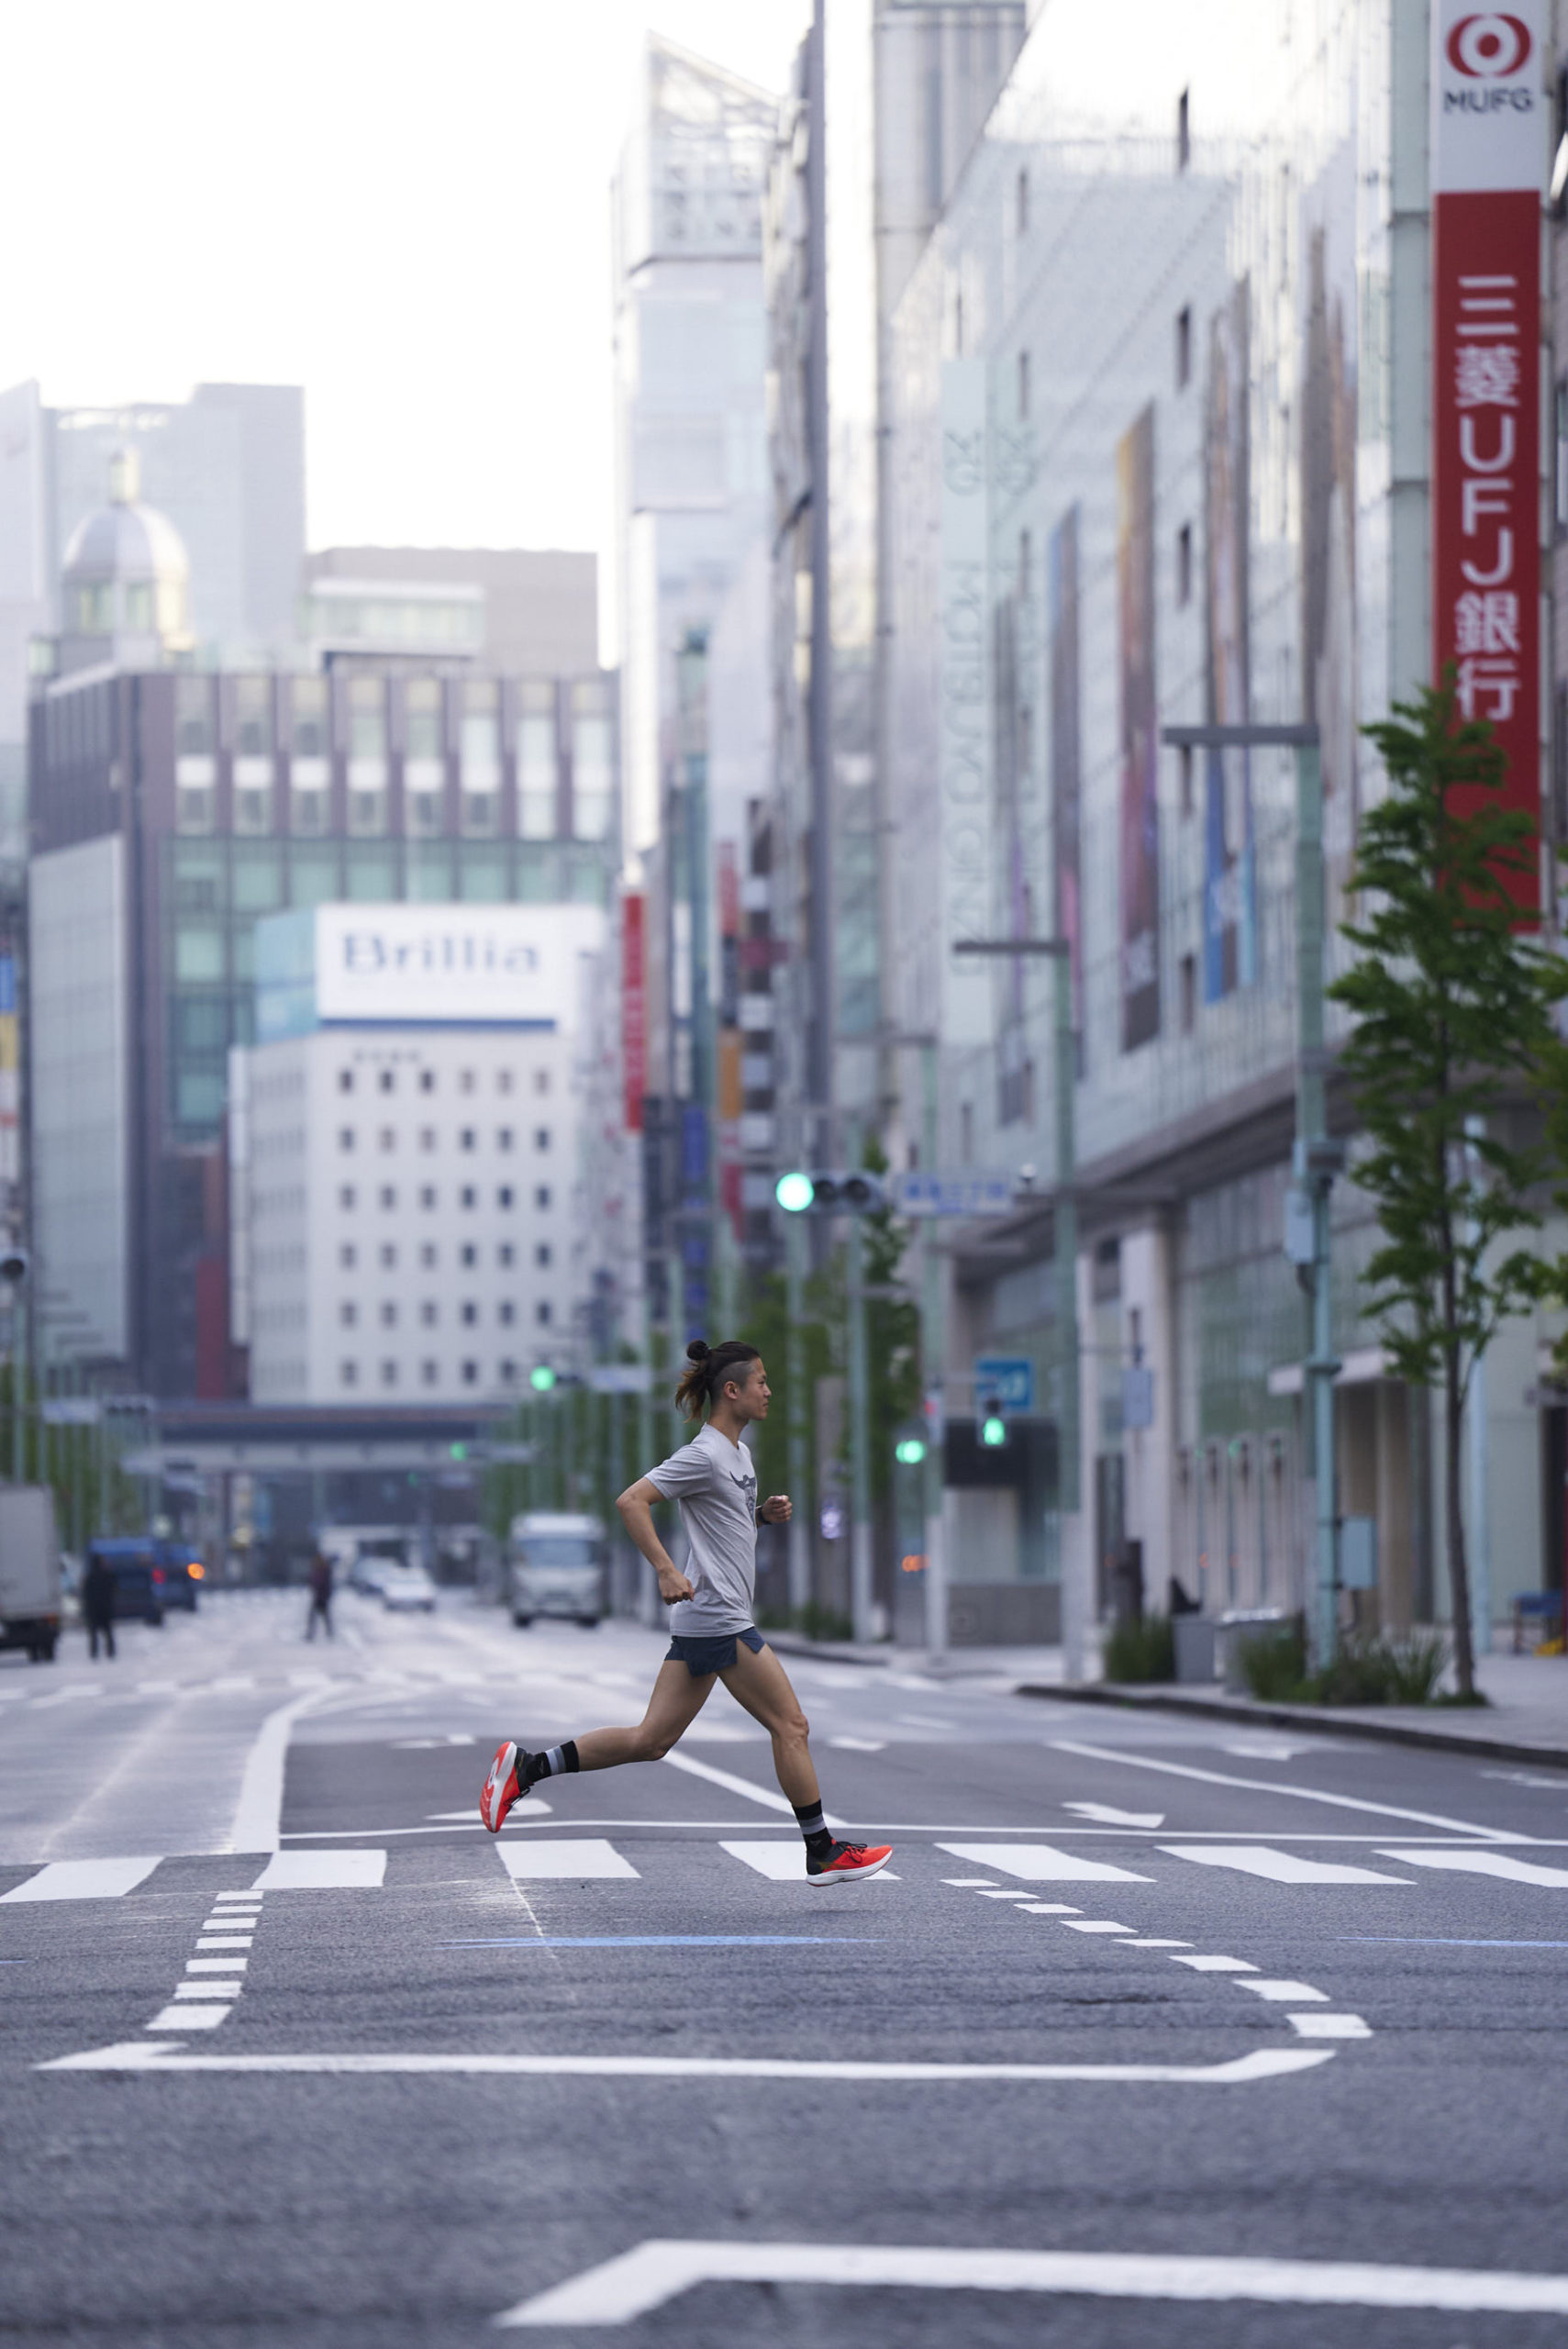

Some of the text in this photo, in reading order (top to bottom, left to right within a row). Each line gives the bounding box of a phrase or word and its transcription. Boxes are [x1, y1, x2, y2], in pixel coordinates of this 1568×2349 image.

[1443, 87, 1534, 113] MUFG
[1454, 274, 1520, 722] 三菱UFJ銀行
[343, 932, 541, 974] Brillia
